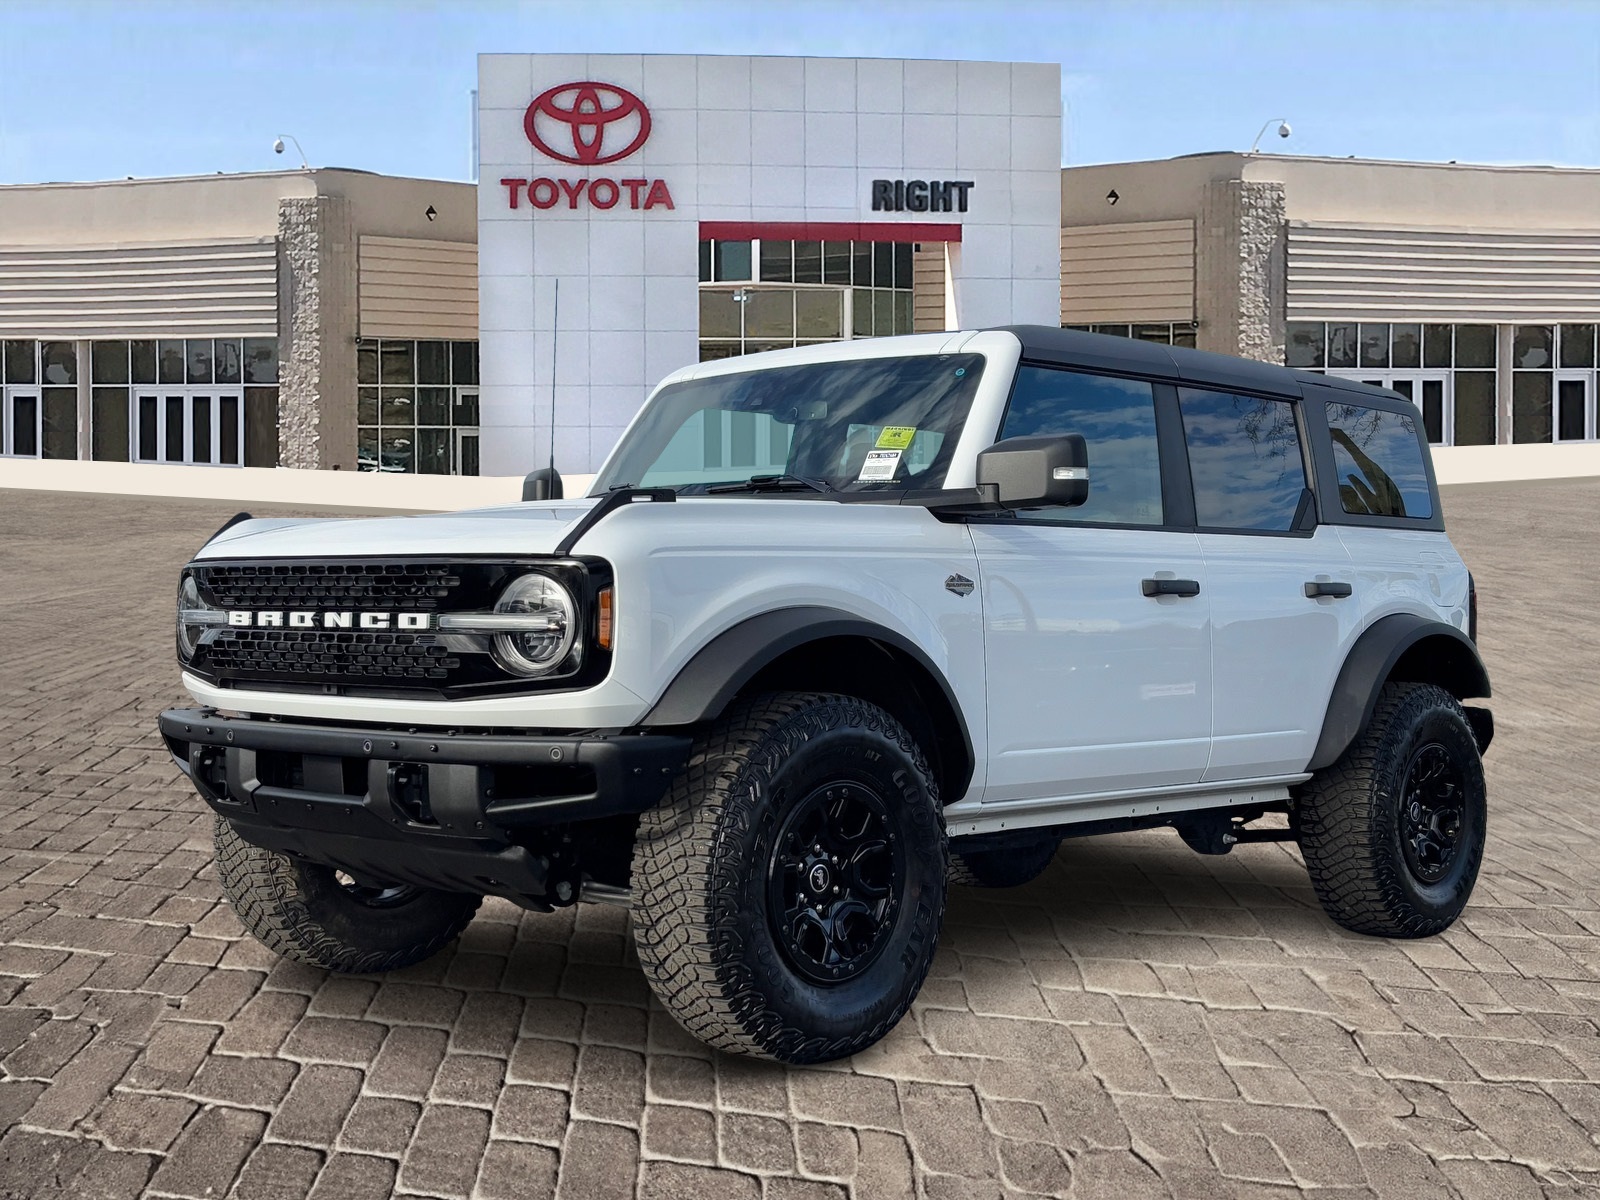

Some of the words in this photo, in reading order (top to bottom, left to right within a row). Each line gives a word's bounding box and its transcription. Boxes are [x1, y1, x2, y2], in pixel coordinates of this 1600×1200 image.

[501, 178, 675, 210] TOYOTA
[872, 179, 975, 213] RIGHT
[228, 610, 431, 630] BRONCO
